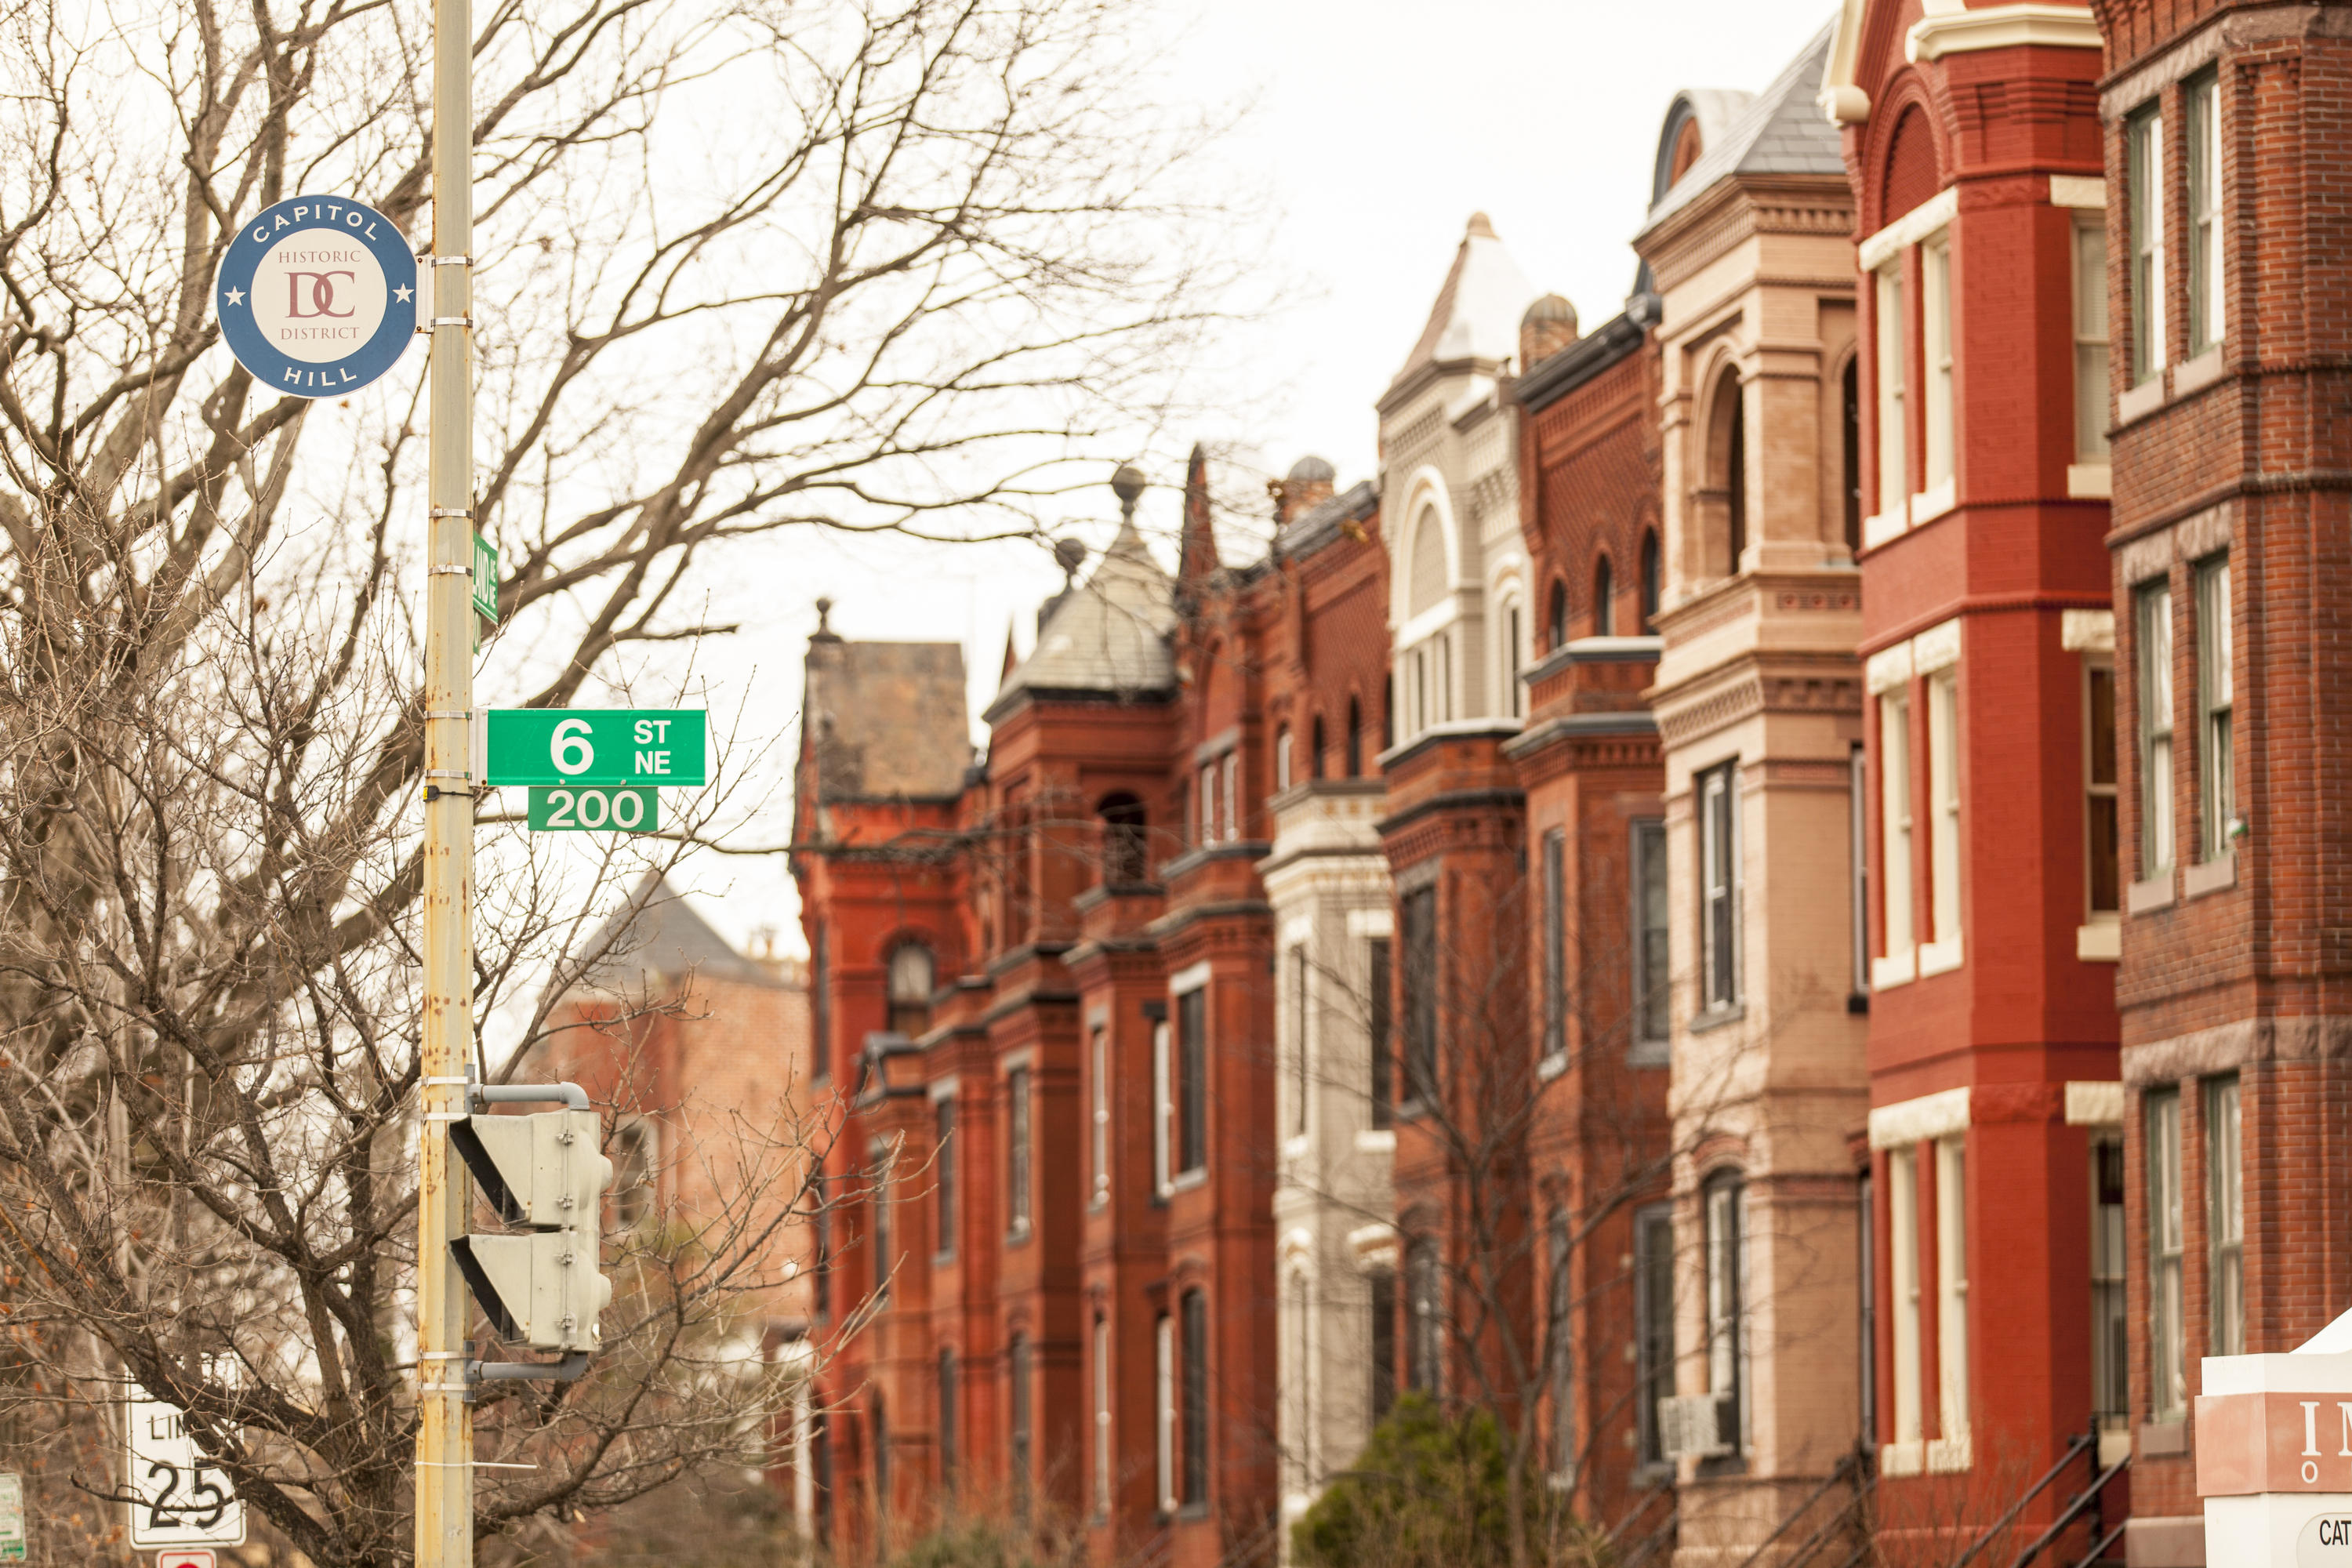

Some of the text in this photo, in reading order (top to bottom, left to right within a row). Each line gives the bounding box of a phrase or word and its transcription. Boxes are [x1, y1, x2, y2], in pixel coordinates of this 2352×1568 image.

[252, 204, 377, 243] CAPITOL
[279, 250, 361, 263] HISTORIC
[284, 270, 355, 318] DC
[281, 326, 360, 340] DISTRICT
[283, 367, 357, 387] HILL
[550, 718, 594, 775] 6
[633, 720, 671, 744] ST
[635, 751, 670, 775] NE
[546, 789, 644, 828] 200
[148, 1461, 224, 1529] 25
